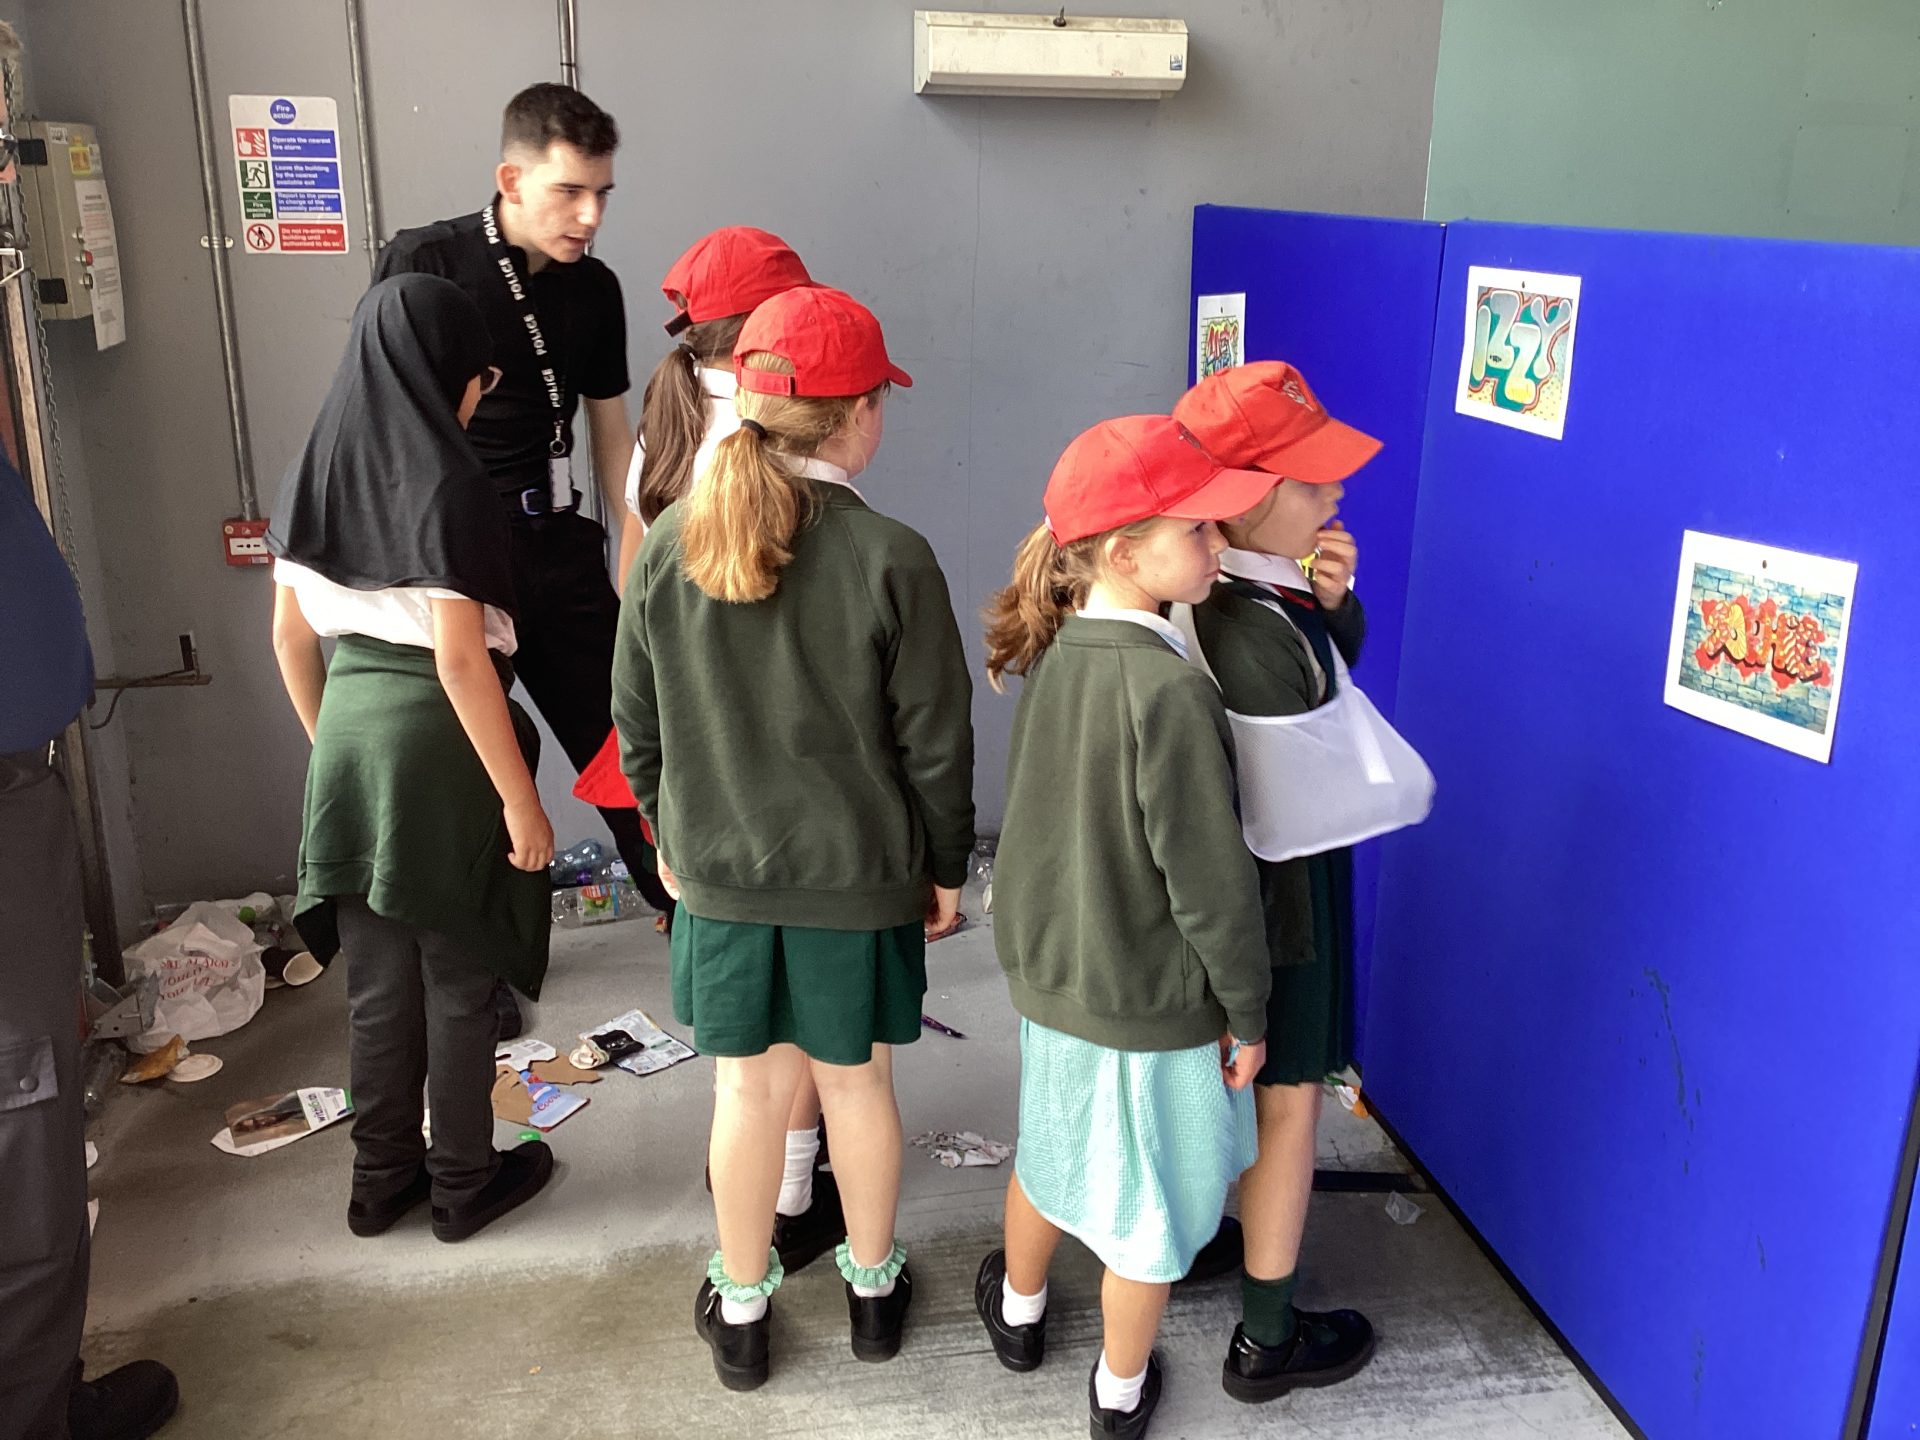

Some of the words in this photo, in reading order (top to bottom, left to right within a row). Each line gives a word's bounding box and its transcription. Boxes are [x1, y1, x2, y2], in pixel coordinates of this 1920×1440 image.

[271, 136, 297, 144] Operate
[304, 165, 330, 173] building
[482, 205, 500, 245] POLIC
[498, 257, 526, 301] POLICE
[523, 313, 548, 356] POLICE
[541, 368, 560, 408] POLICE
